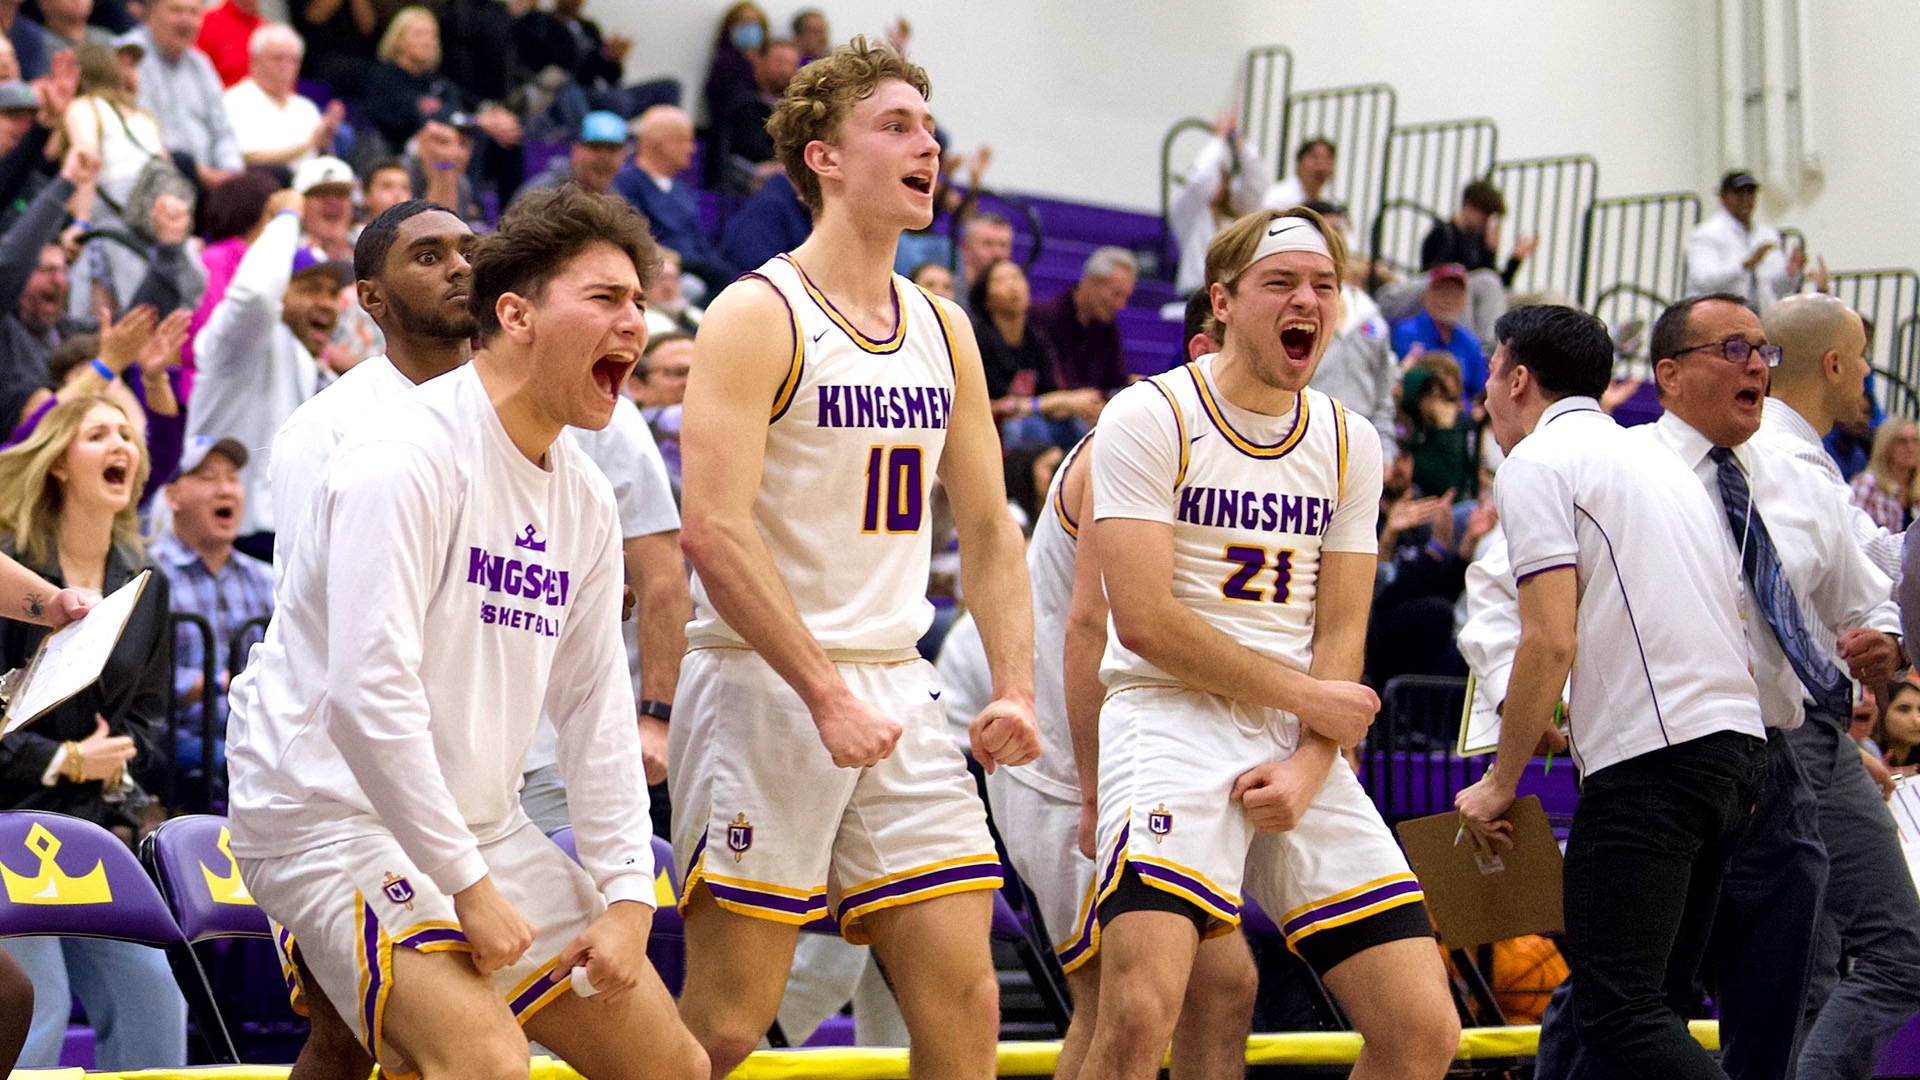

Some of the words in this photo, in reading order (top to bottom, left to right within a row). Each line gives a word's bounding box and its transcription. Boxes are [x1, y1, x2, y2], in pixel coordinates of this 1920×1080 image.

[817, 385, 951, 429] KINGSMEN
[861, 445, 924, 534] 10
[1178, 487, 1334, 536] KINGSMEN
[1220, 543, 1296, 605] 21
[731, 828, 749, 850] CL
[1151, 815, 1169, 833] CL
[386, 882, 412, 901] CL
